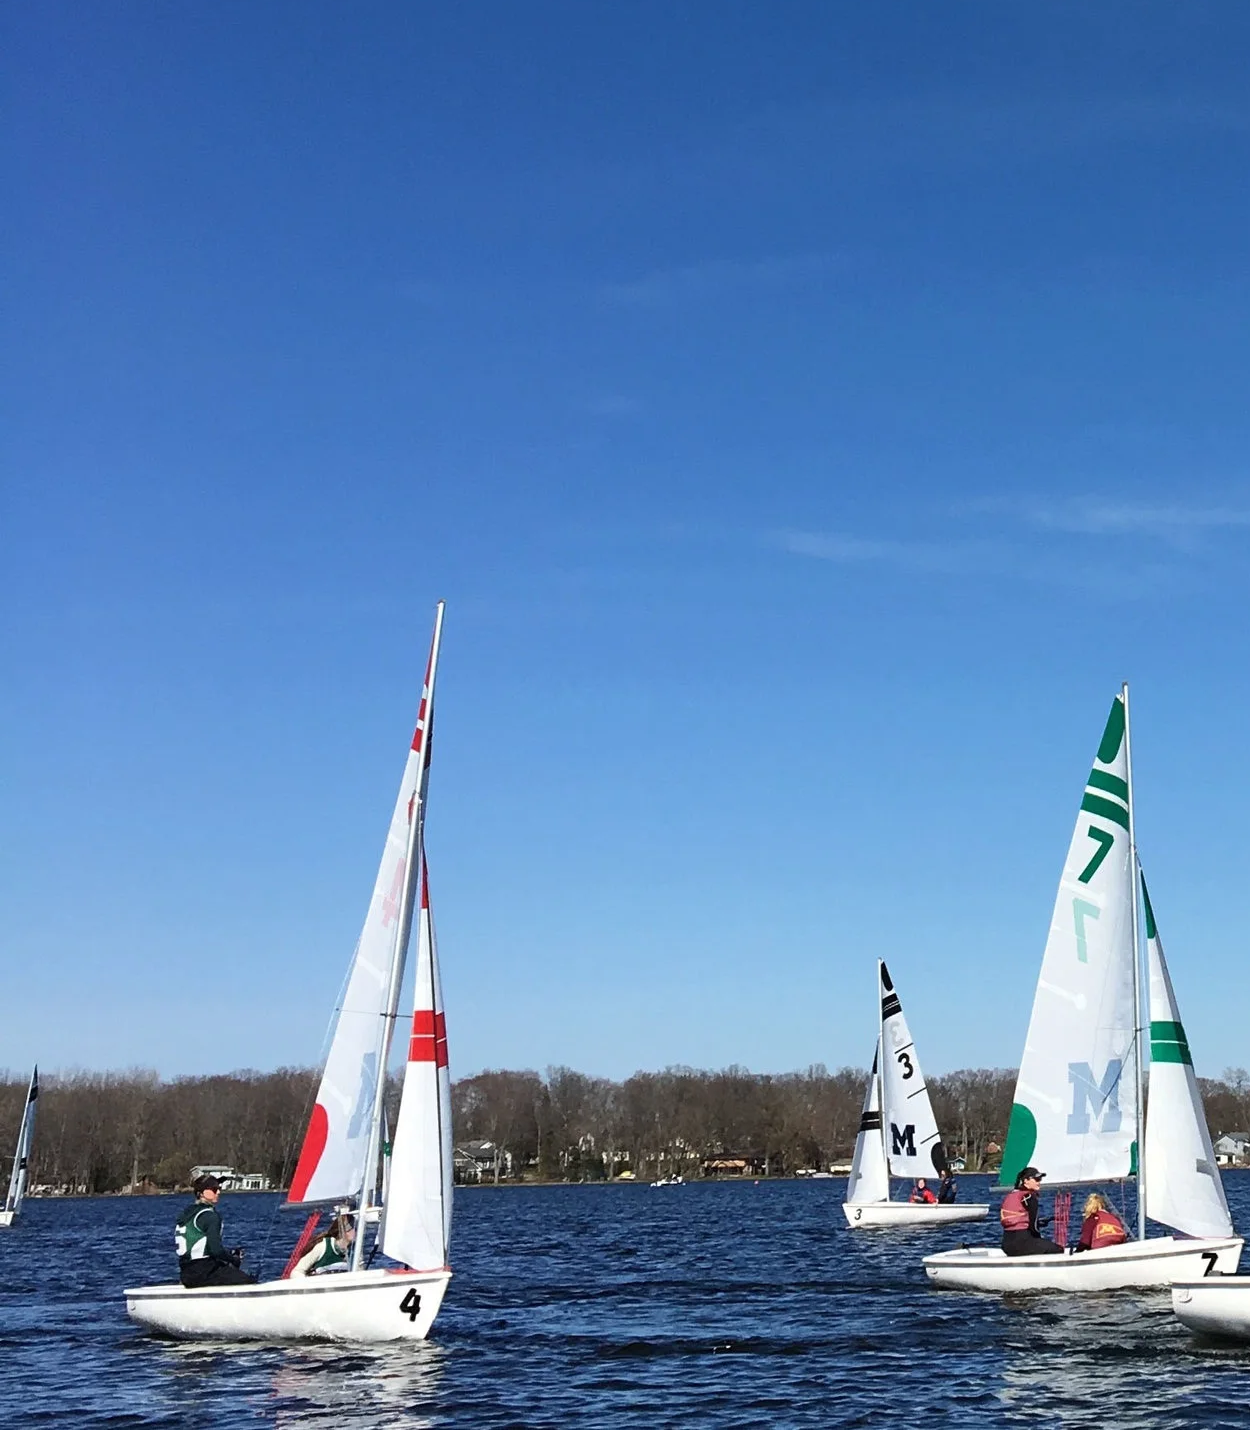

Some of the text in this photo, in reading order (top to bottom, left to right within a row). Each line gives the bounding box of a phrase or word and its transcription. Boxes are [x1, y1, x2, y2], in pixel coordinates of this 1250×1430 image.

[1078, 825, 1114, 884] 7
[898, 1052, 914, 1080] 3
[1066, 1058, 1123, 1134] M
[891, 1122, 917, 1157] M
[854, 1208, 863, 1221] 3
[1201, 1252, 1219, 1277] 7
[399, 1288, 421, 1322] 4
